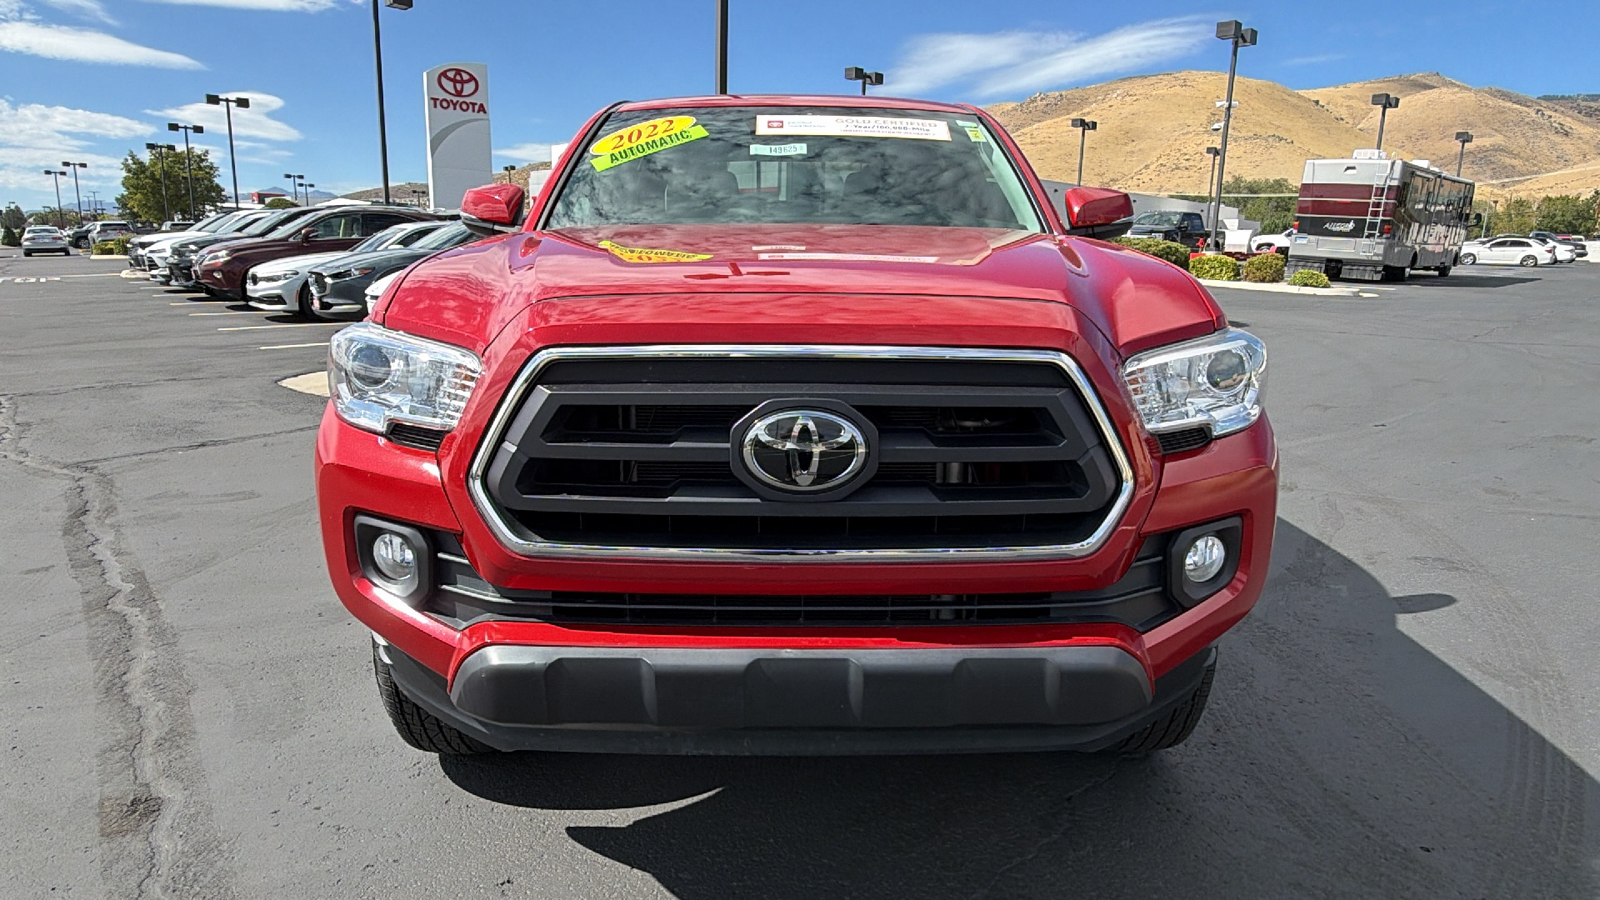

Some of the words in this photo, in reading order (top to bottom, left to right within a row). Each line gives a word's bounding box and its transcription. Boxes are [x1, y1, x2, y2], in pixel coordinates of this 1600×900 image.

[430, 97, 487, 114] TOYOTA
[611, 119, 675, 150] 2022
[874, 119, 937, 128] CERTIFIED
[609, 130, 693, 164] AUTOMATIC
